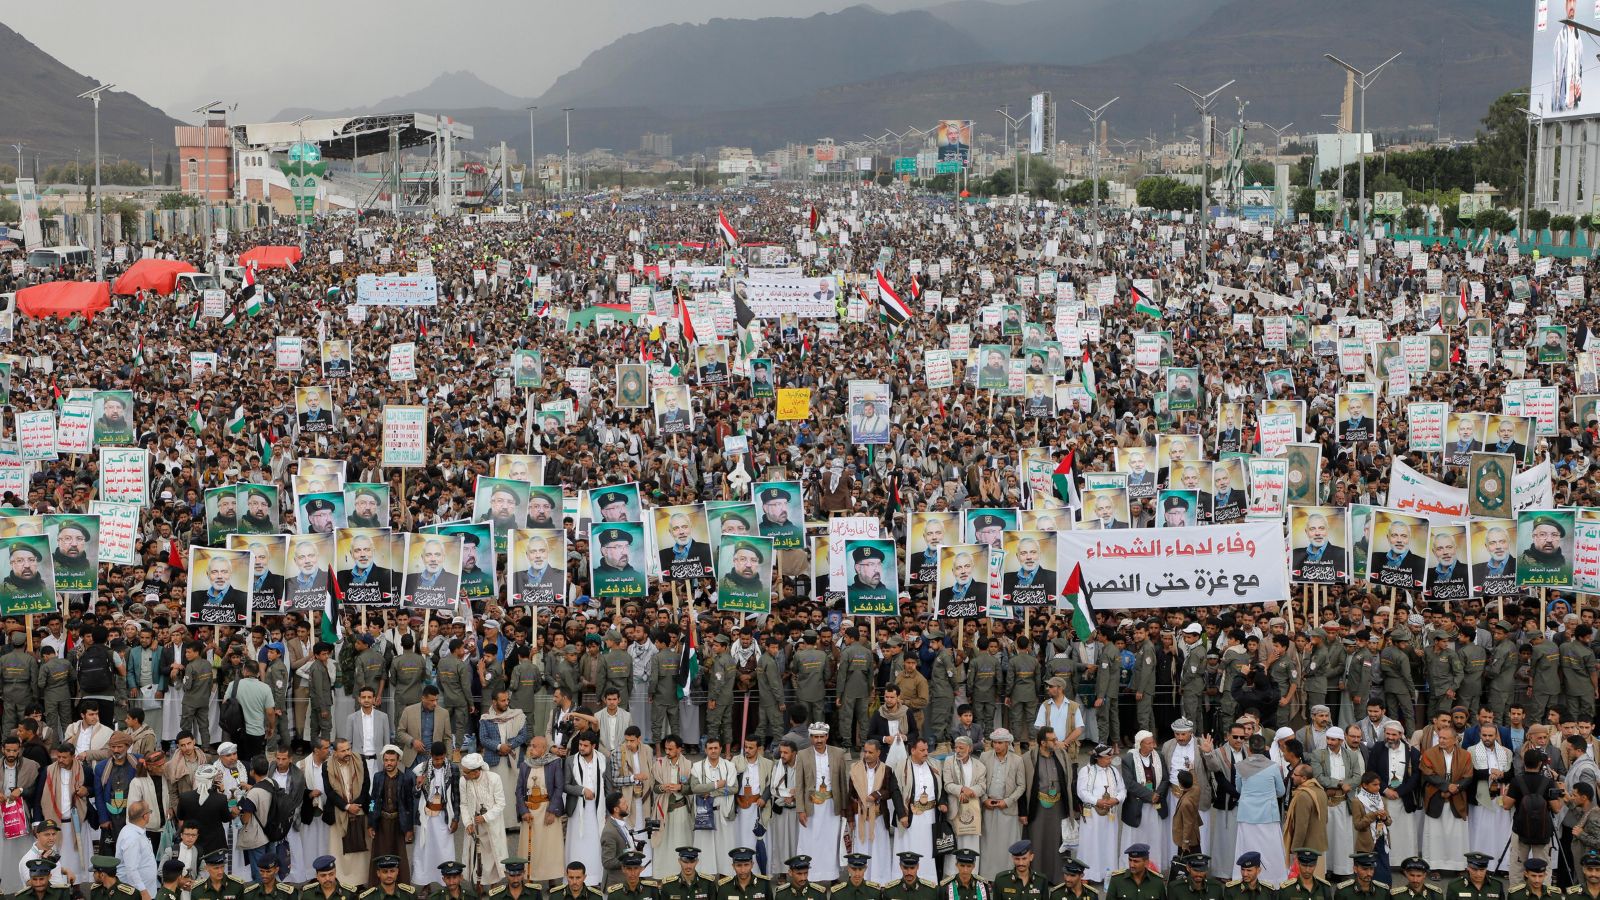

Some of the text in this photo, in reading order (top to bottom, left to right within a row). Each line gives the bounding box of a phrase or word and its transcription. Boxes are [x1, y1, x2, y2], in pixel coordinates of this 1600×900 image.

[782, 537, 800, 546] فؤاد
[1086, 531, 1256, 558] وفاء لدماء الشهداء
[55, 580, 92, 588] فؤاد شك
[1086, 568, 1260, 601] مع غزة حتى النصر
[1521, 575, 1568, 585] فؤاد شكر
[599, 584, 642, 595] فؤاد شكر
[6, 600, 52, 613] فؤاد شكر
[723, 599, 744, 608] شكر
[853, 602, 894, 612] فؤاد شكر
